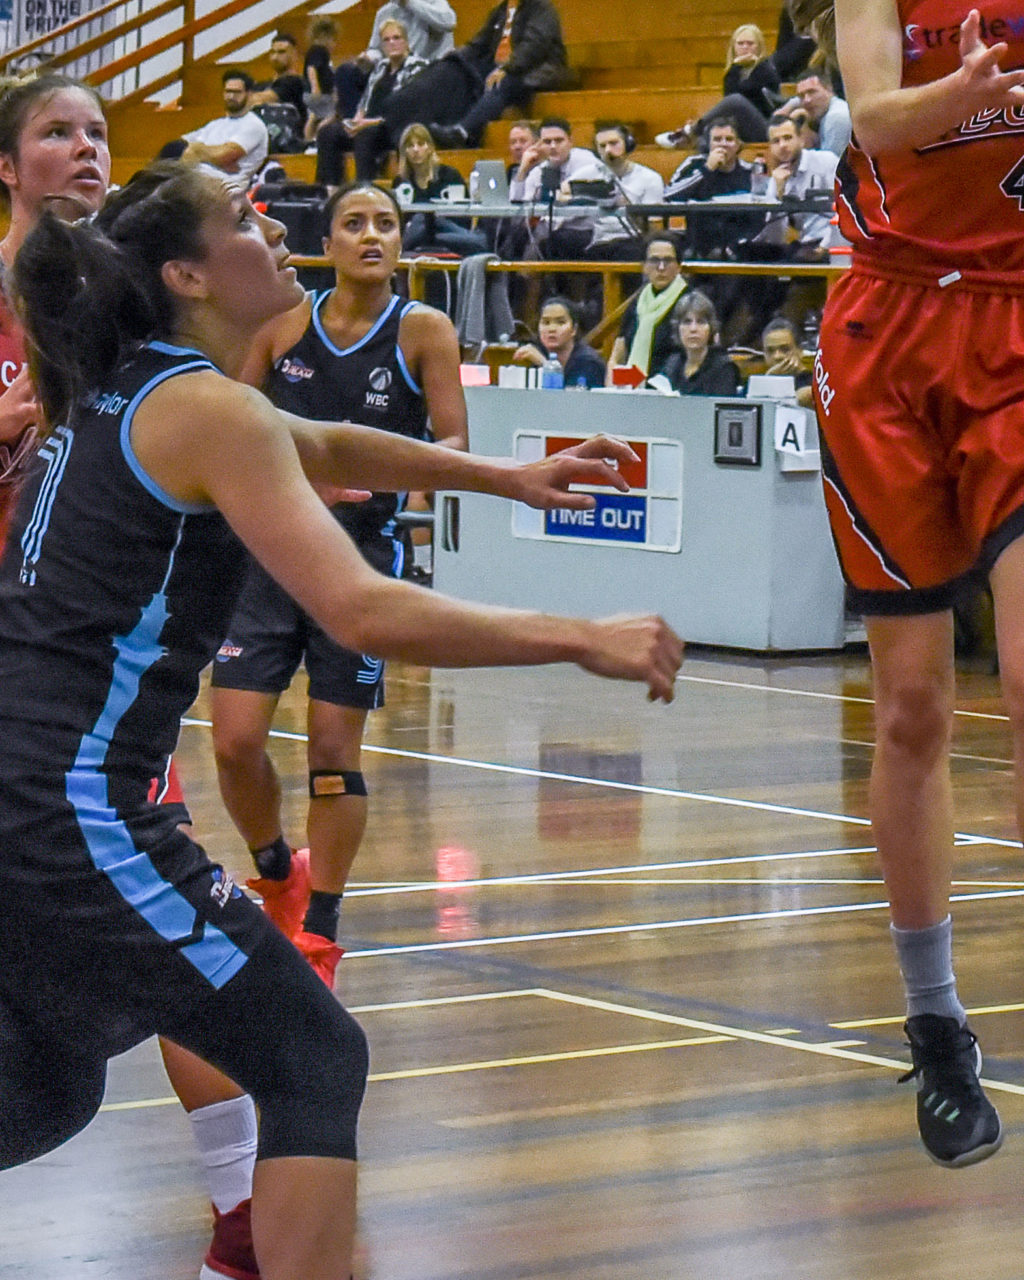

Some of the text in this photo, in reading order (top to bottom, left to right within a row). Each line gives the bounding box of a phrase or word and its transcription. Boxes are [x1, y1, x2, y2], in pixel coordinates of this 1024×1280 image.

[25, 0, 80, 16] ON THE
[364, 390, 390, 408] WBC
[781, 422, 800, 452] A
[551, 506, 645, 531] TIME OUT
